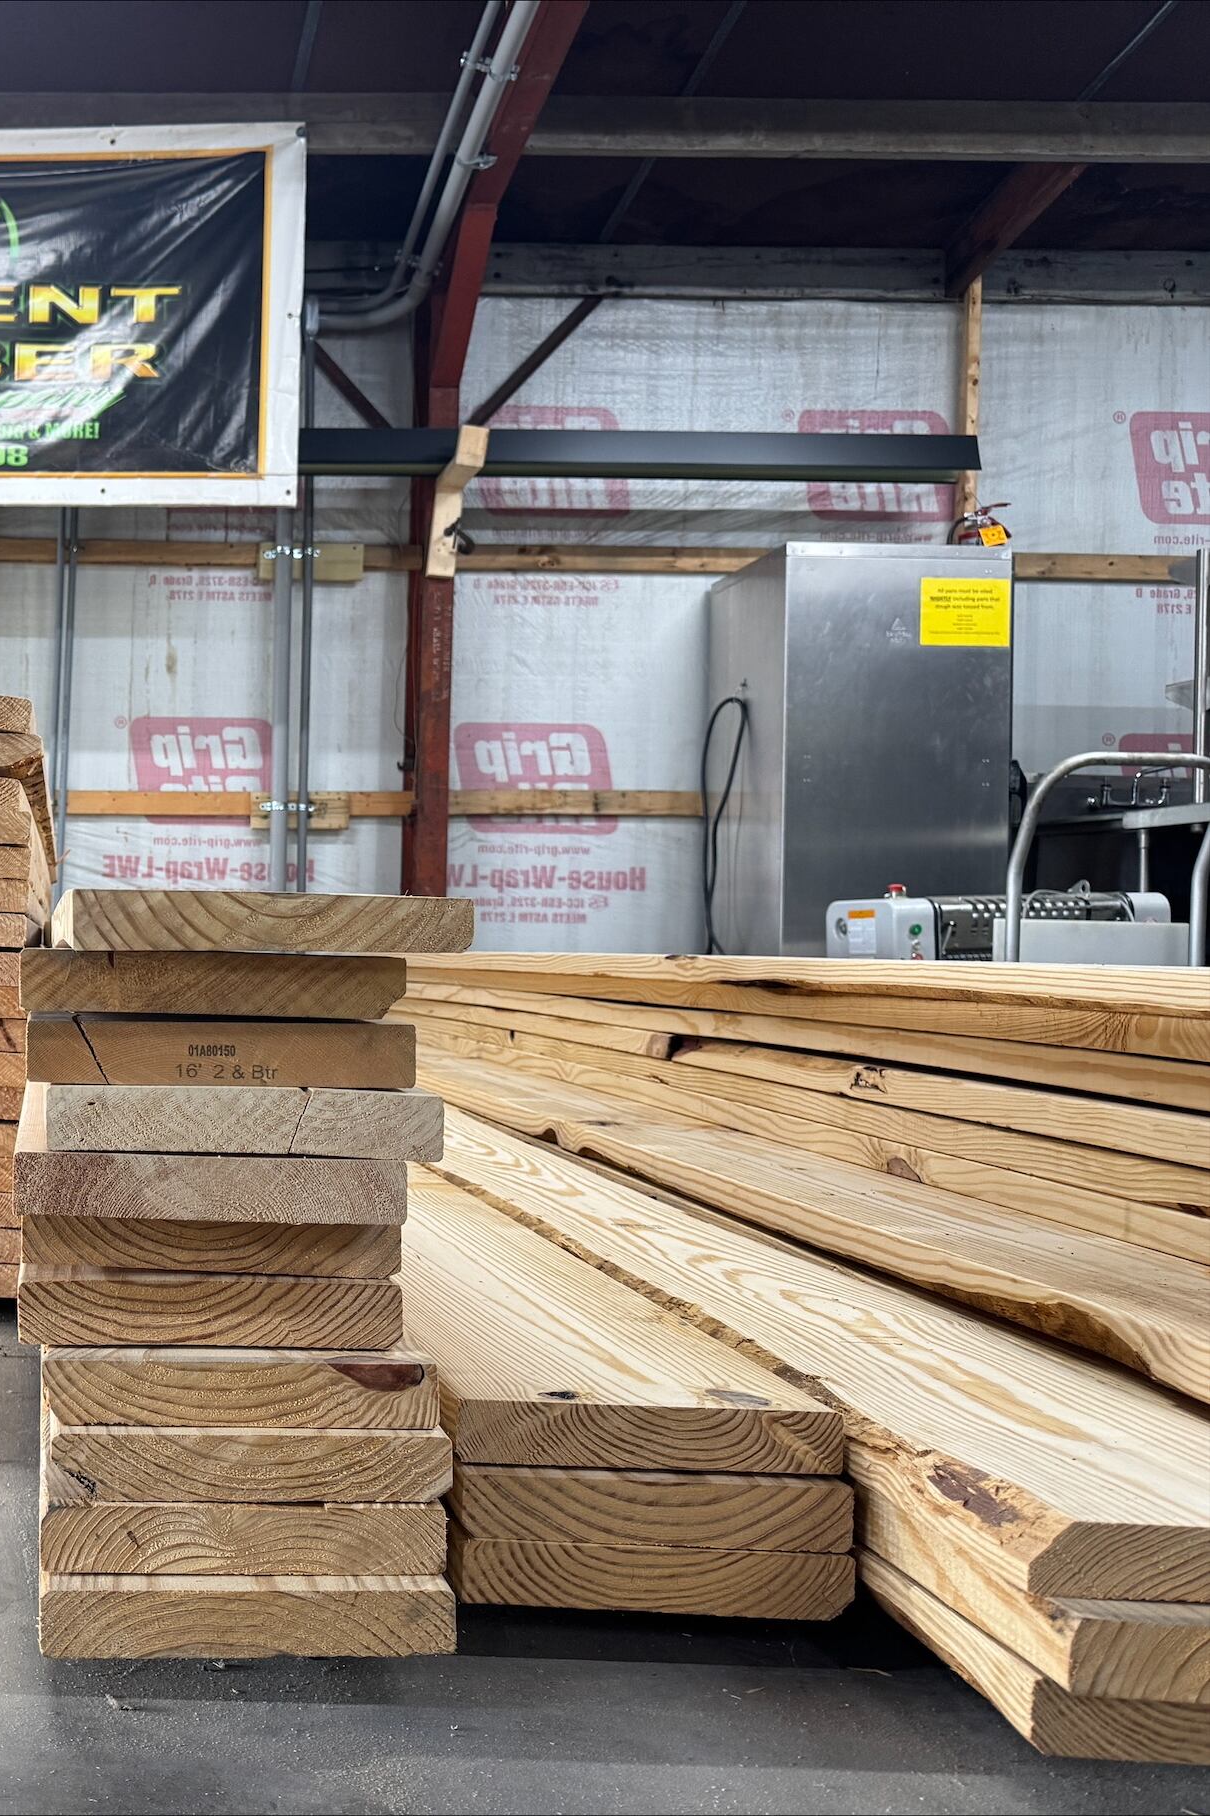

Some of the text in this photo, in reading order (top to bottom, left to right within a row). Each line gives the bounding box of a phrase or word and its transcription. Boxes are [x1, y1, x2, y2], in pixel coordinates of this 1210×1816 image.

[29, 425, 39, 439] &
[187, 1044, 236, 1057] 01A80150
[175, 1063, 278, 1080] 16' 2 & Btr
